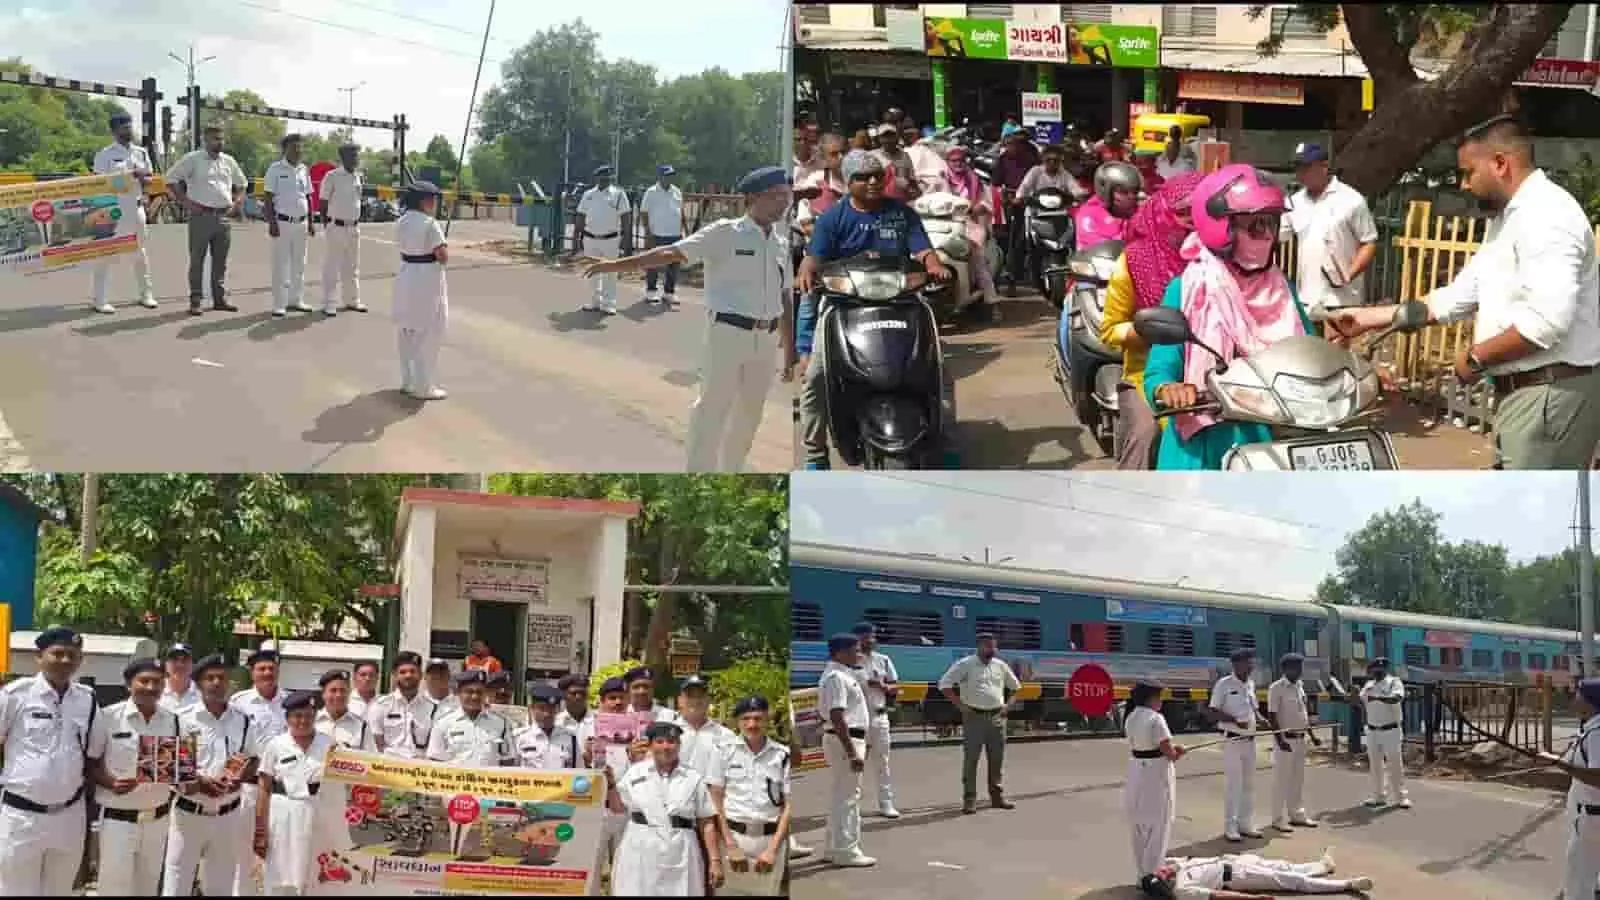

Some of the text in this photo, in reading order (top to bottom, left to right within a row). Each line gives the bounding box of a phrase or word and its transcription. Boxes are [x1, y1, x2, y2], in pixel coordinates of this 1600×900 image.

[1009, 24, 1062, 44] ગાયત્રી
[1316, 444, 1359, 465] GJ06
[1072, 682, 1110, 698] STOP
